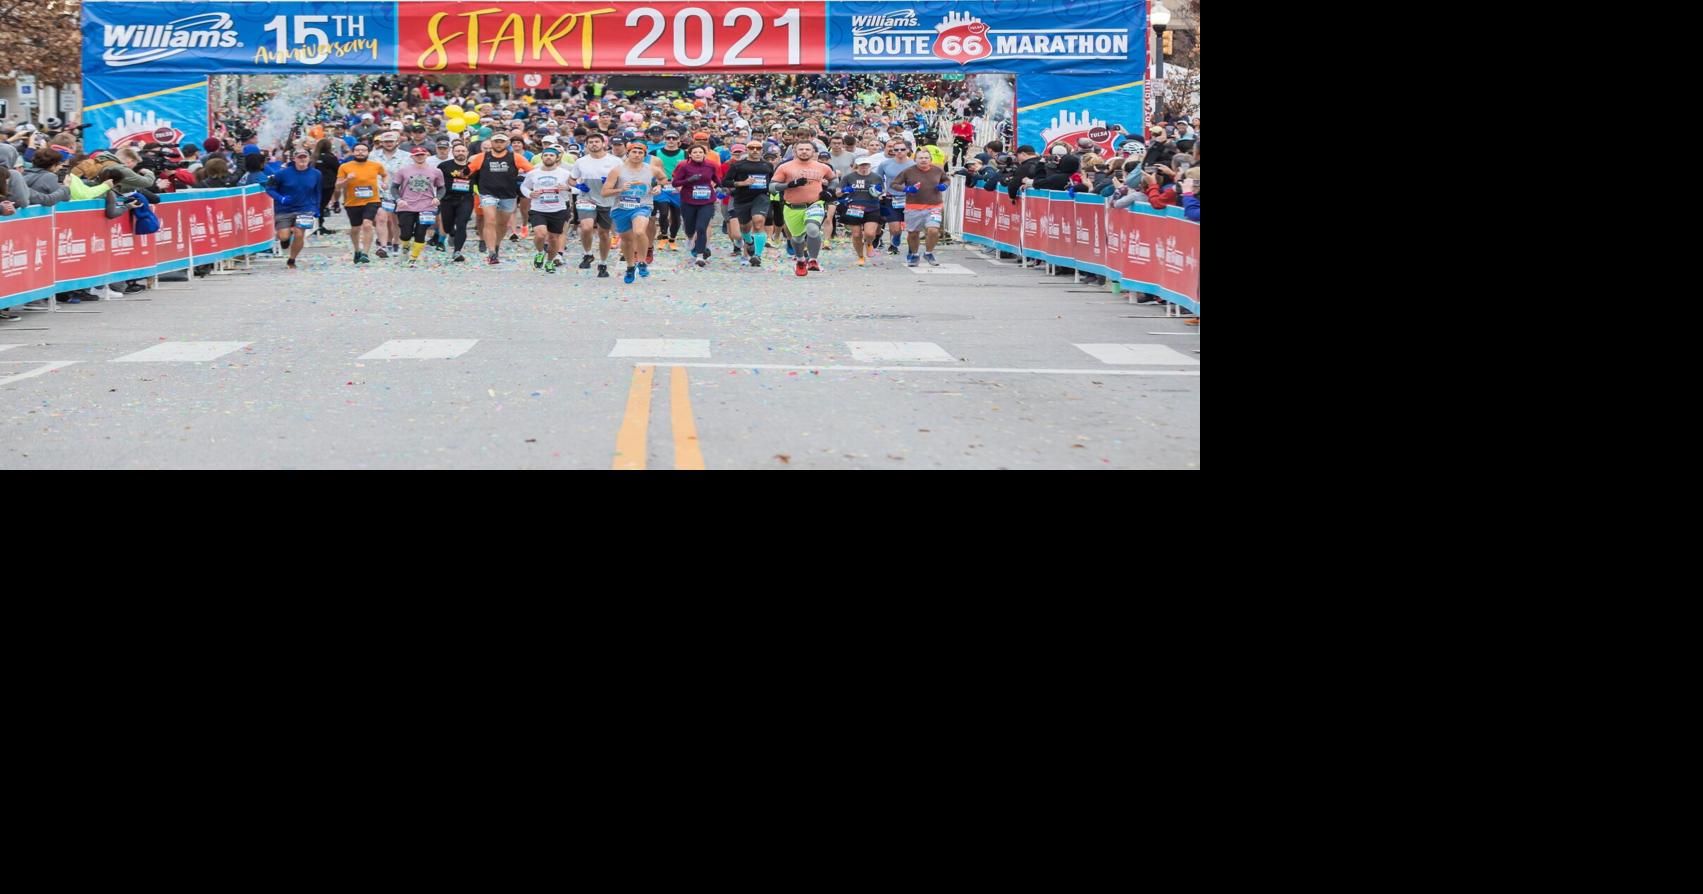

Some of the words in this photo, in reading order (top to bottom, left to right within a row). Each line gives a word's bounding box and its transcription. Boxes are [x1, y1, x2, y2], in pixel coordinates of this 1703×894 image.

[852, 15, 918, 27] Williams
[103, 24, 238, 48] Williams
[417, 8, 617, 70] START
[625, 7, 801, 66] 2021
[853, 36, 930, 55] ROUTE
[941, 35, 983, 56] 66
[996, 34, 1128, 54] MARATHON
[252, 38, 378, 64] Anniversary
